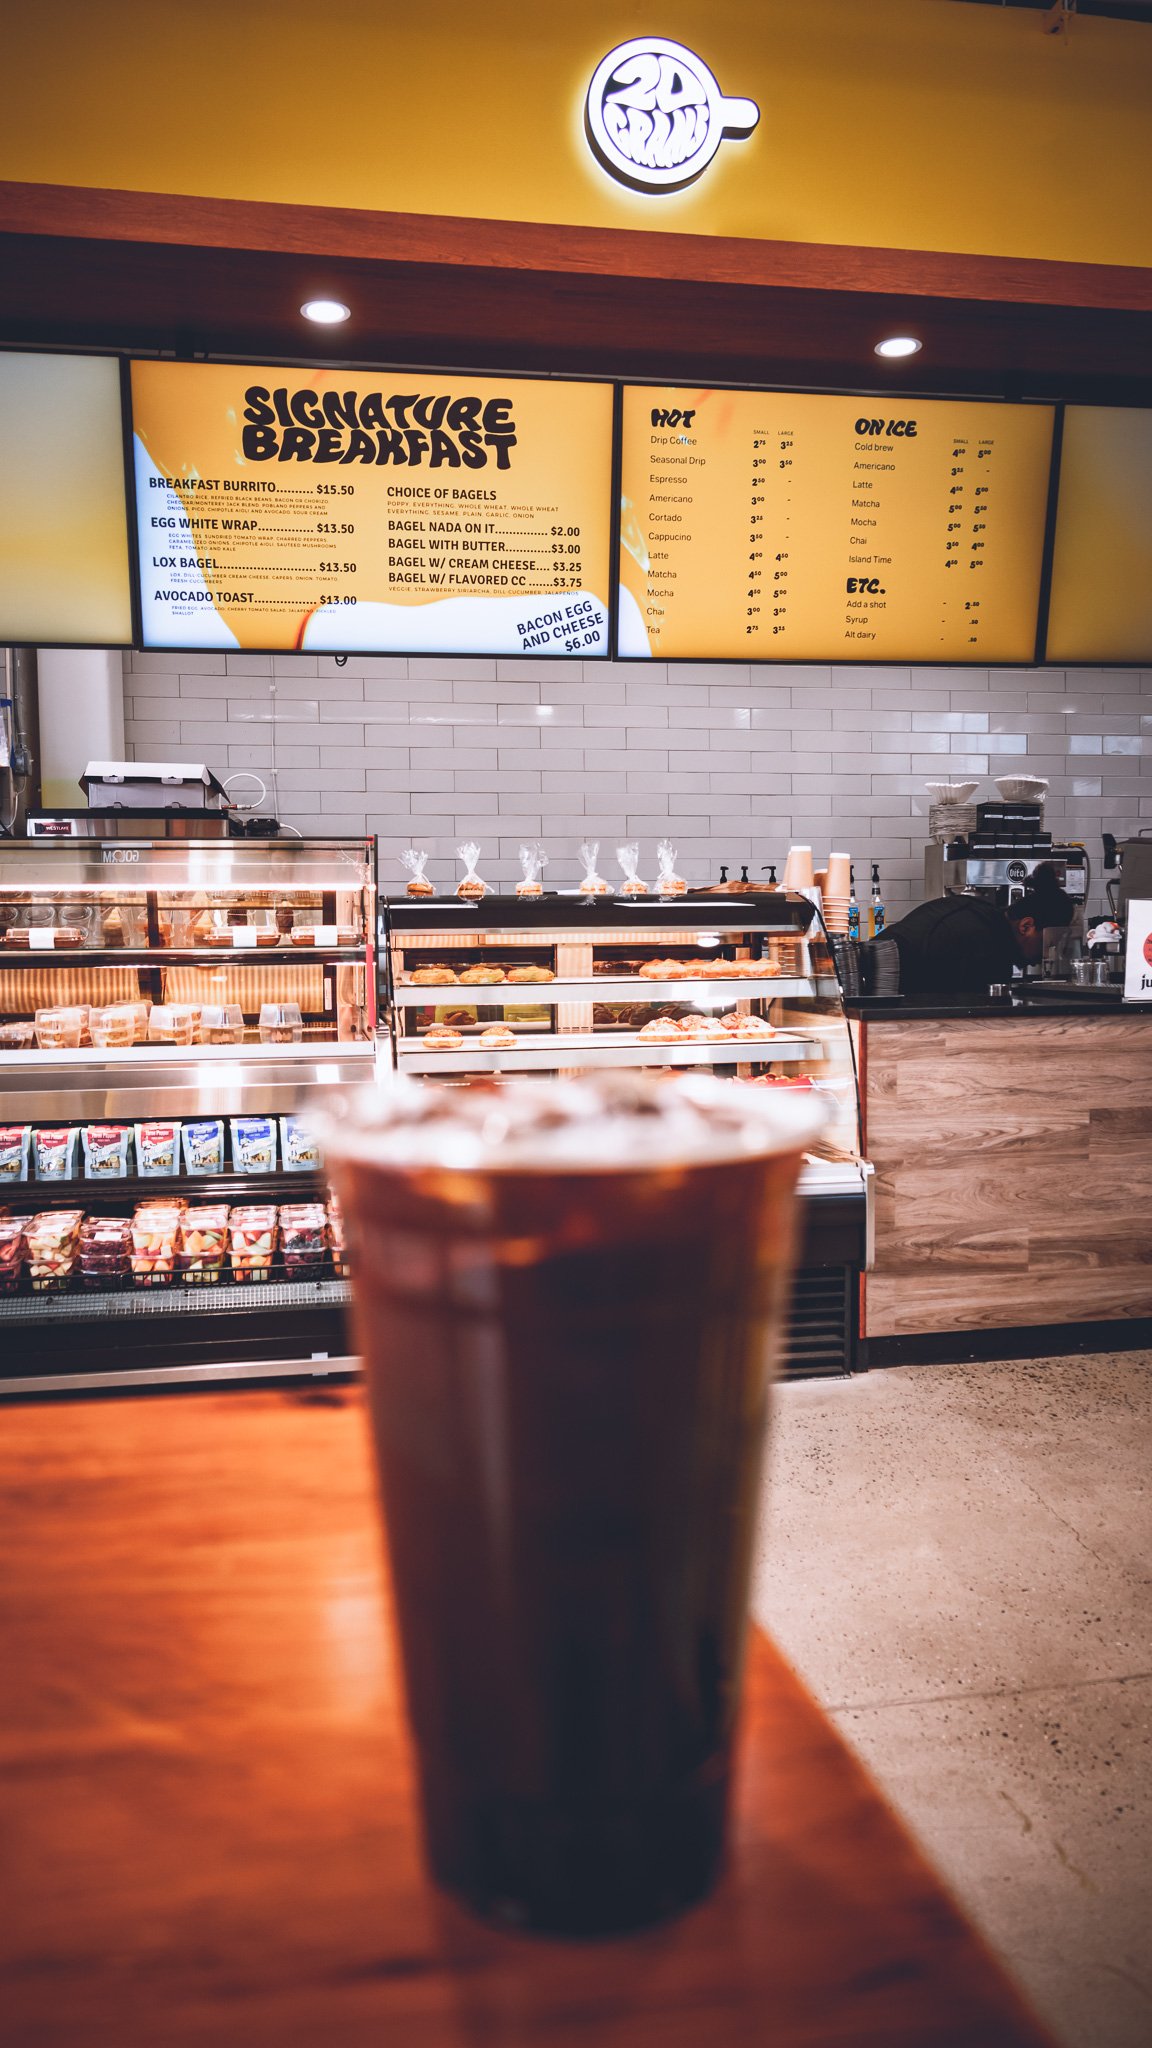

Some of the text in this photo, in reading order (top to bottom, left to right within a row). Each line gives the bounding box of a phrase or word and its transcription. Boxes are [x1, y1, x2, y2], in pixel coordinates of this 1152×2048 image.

[243, 385, 516, 433] SIGNATURE
[651, 408, 696, 428] HOT
[854, 418, 918, 437] ON ICE
[650, 435, 668, 445] Drip
[669, 436, 697, 445] Coffee
[242, 424, 518, 470] BREAKFAST
[854, 442, 873, 451] Cold
[874, 443, 894, 452] brew
[650, 455, 687, 464] Seasonal
[689, 456, 706, 467] Drip
[853, 461, 896, 471] Americano
[649, 474, 688, 484] Espresso
[149, 477, 355, 495] BREAKFAST BURRITO $15.50
[852, 480, 873, 489] Latte
[387, 486, 497, 501] CHOICE OF BAGELS
[649, 494, 693, 503] Americano
[851, 499, 880, 508] Matcha
[648, 513, 682, 522] Cortado
[850, 518, 877, 527] Mocha
[150, 517, 355, 534] EGG WHITE WRAP $13.50
[388, 520, 580, 537] BAGEL NADA ON IT $2.00
[648, 532, 692, 543] Cappucino
[849, 536, 867, 545] Chai
[388, 538, 581, 554] BAGEL WITH BUTTER $3.00
[648, 551, 669, 560] Latte
[848, 555, 872, 564] Island
[874, 556, 892, 564] Time
[152, 556, 357, 573] LOX BAGEL $13.50
[388, 556, 582, 572] BAGEL W/ CREAM CHEESE $3.25
[647, 570, 677, 579] Matcha
[388, 572, 582, 588] BAGEL W/ FLAVORED CC $3.75
[846, 577, 886, 594] ETC.
[154, 590, 357, 606] AVOCADO TOAST $13.00
[647, 589, 674, 597] Mocha
[846, 600, 862, 609] Add
[869, 600, 886, 609] shot
[646, 607, 665, 616] Chai
[516, 600, 593, 636] BACON EGG
[845, 615, 868, 624] Syrup
[522, 612, 604, 650] AND CHEESE
[646, 626, 660, 634] Tea
[845, 631, 856, 639] Alt
[857, 631, 876, 640] dairy
[565, 630, 600, 652] $6.00
